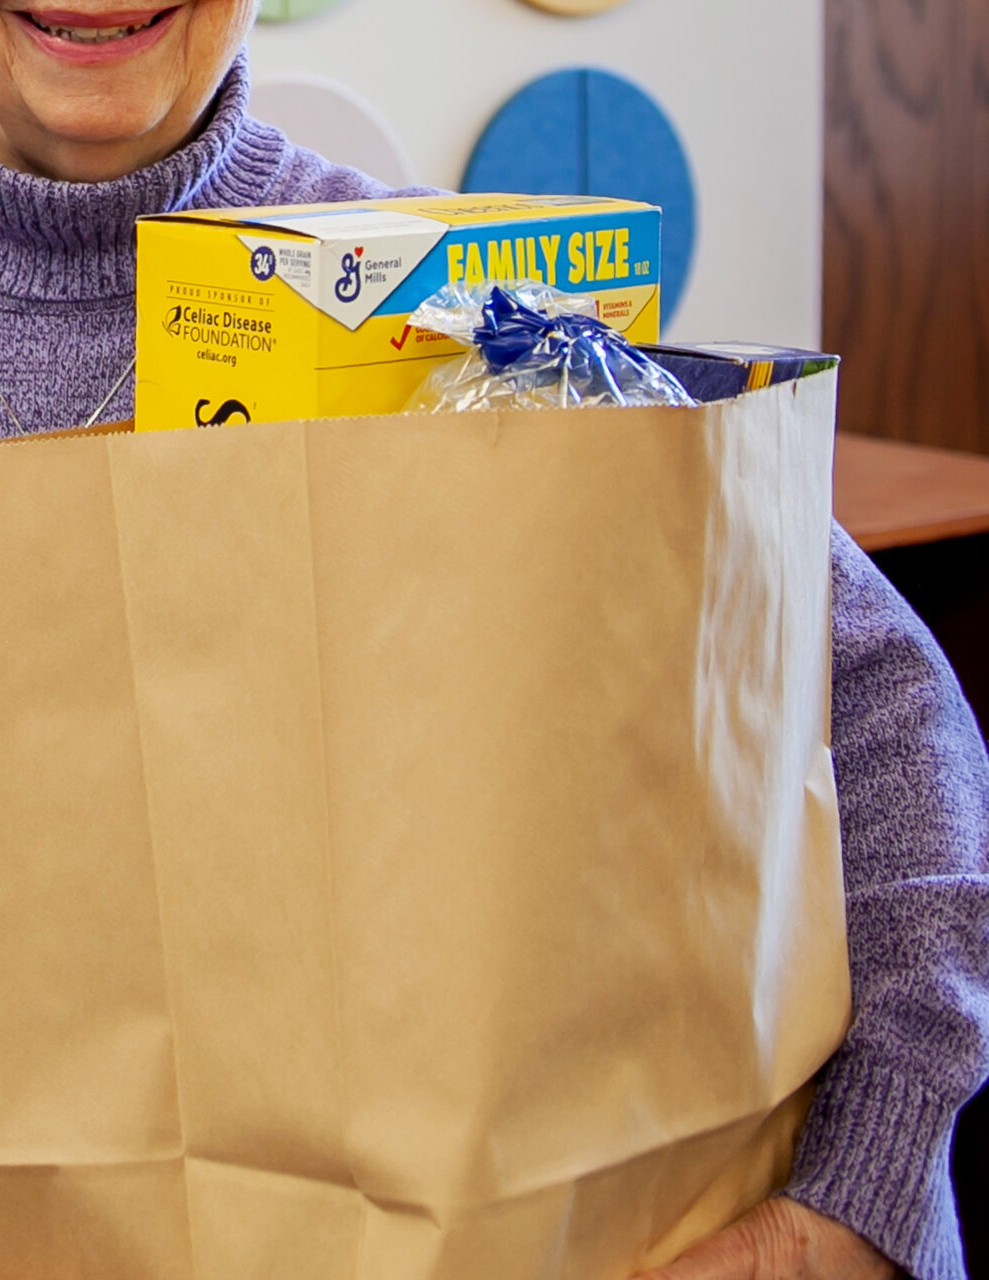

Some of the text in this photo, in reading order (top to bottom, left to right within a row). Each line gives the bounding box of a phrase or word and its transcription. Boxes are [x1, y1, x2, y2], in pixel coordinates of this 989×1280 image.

[364, 257, 402, 271] General
[446, 227, 630, 295] FAMILY SIZE
[364, 272, 387, 284] Mills
[170, 284, 270, 307] PROUD SPONSOR OF
[183, 306, 272, 334] Celiac Disease
[197, 348, 237, 368] celiac.org
